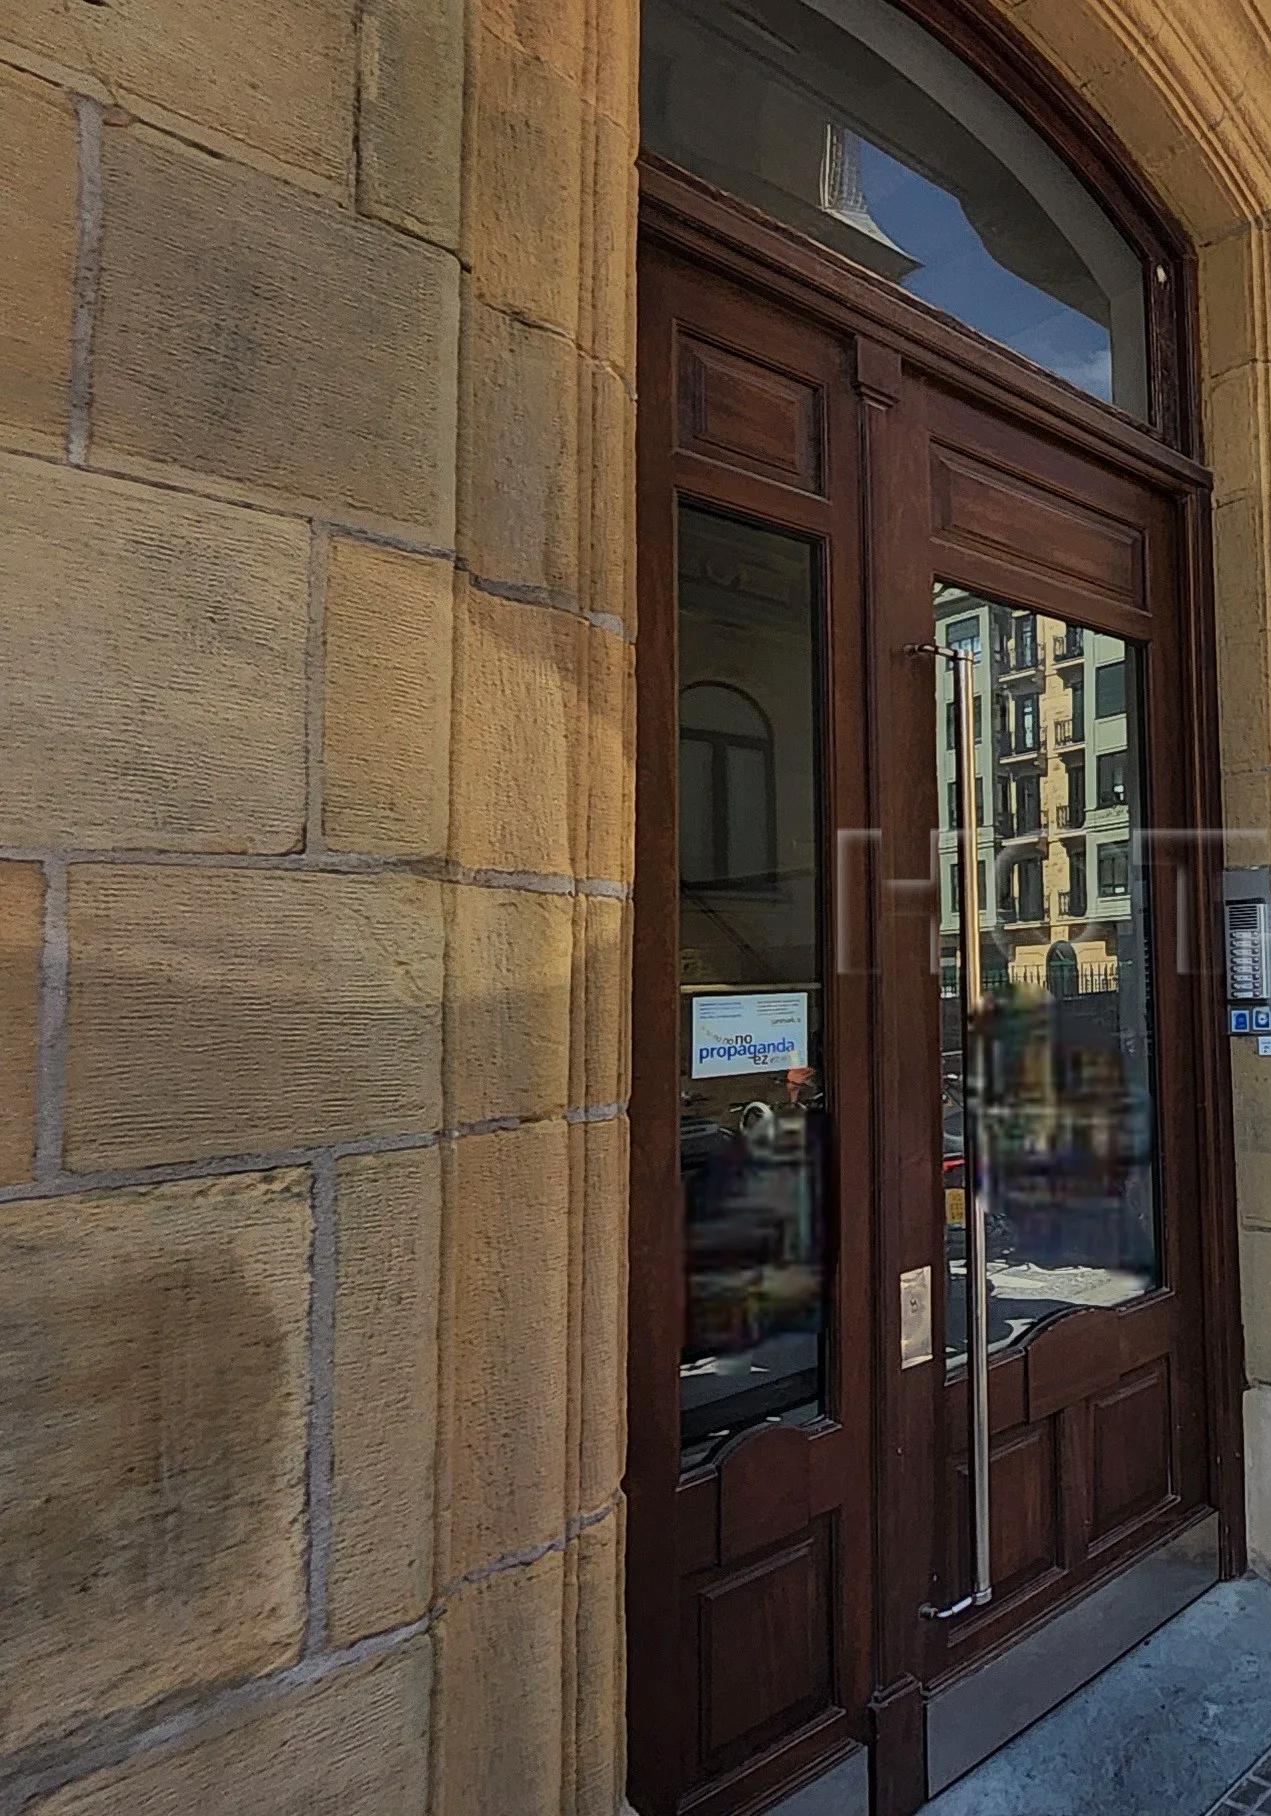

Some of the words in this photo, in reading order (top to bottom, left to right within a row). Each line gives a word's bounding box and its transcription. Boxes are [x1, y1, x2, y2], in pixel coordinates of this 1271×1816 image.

[735, 1034, 753, 1045] no
[699, 1037, 795, 1064] propaganda
[753, 1054, 769, 1065] ez
